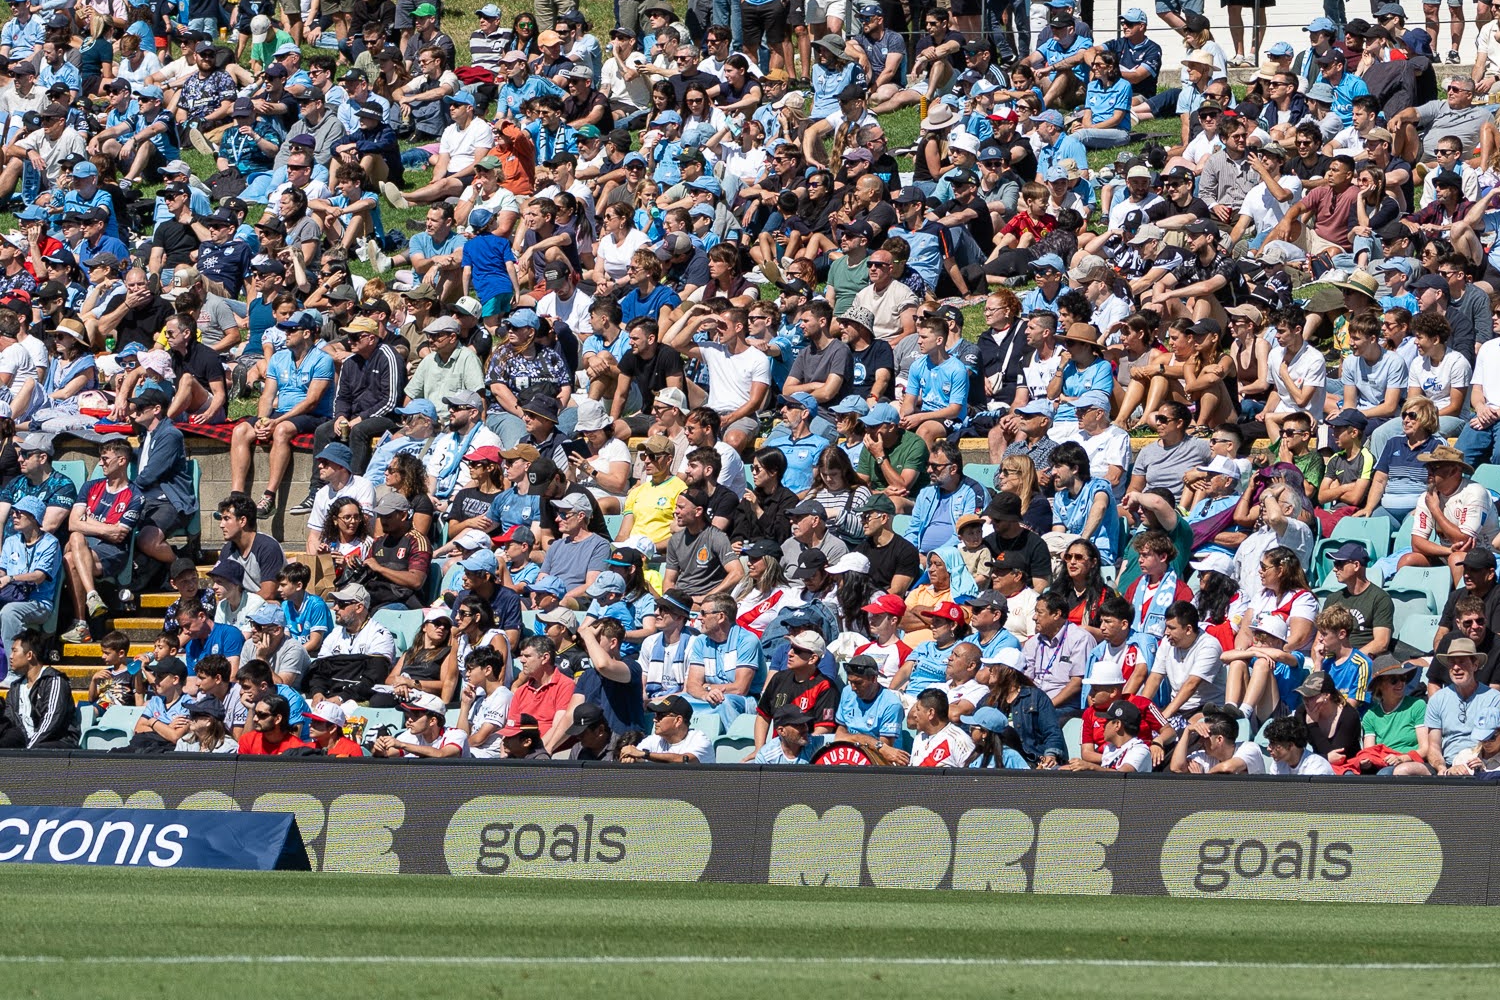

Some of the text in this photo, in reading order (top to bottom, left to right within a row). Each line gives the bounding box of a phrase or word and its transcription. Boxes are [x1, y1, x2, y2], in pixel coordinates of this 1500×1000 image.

[476, 814, 627, 874] goals
[767, 803, 1120, 896] MORE
[1194, 830, 1353, 893] goals
